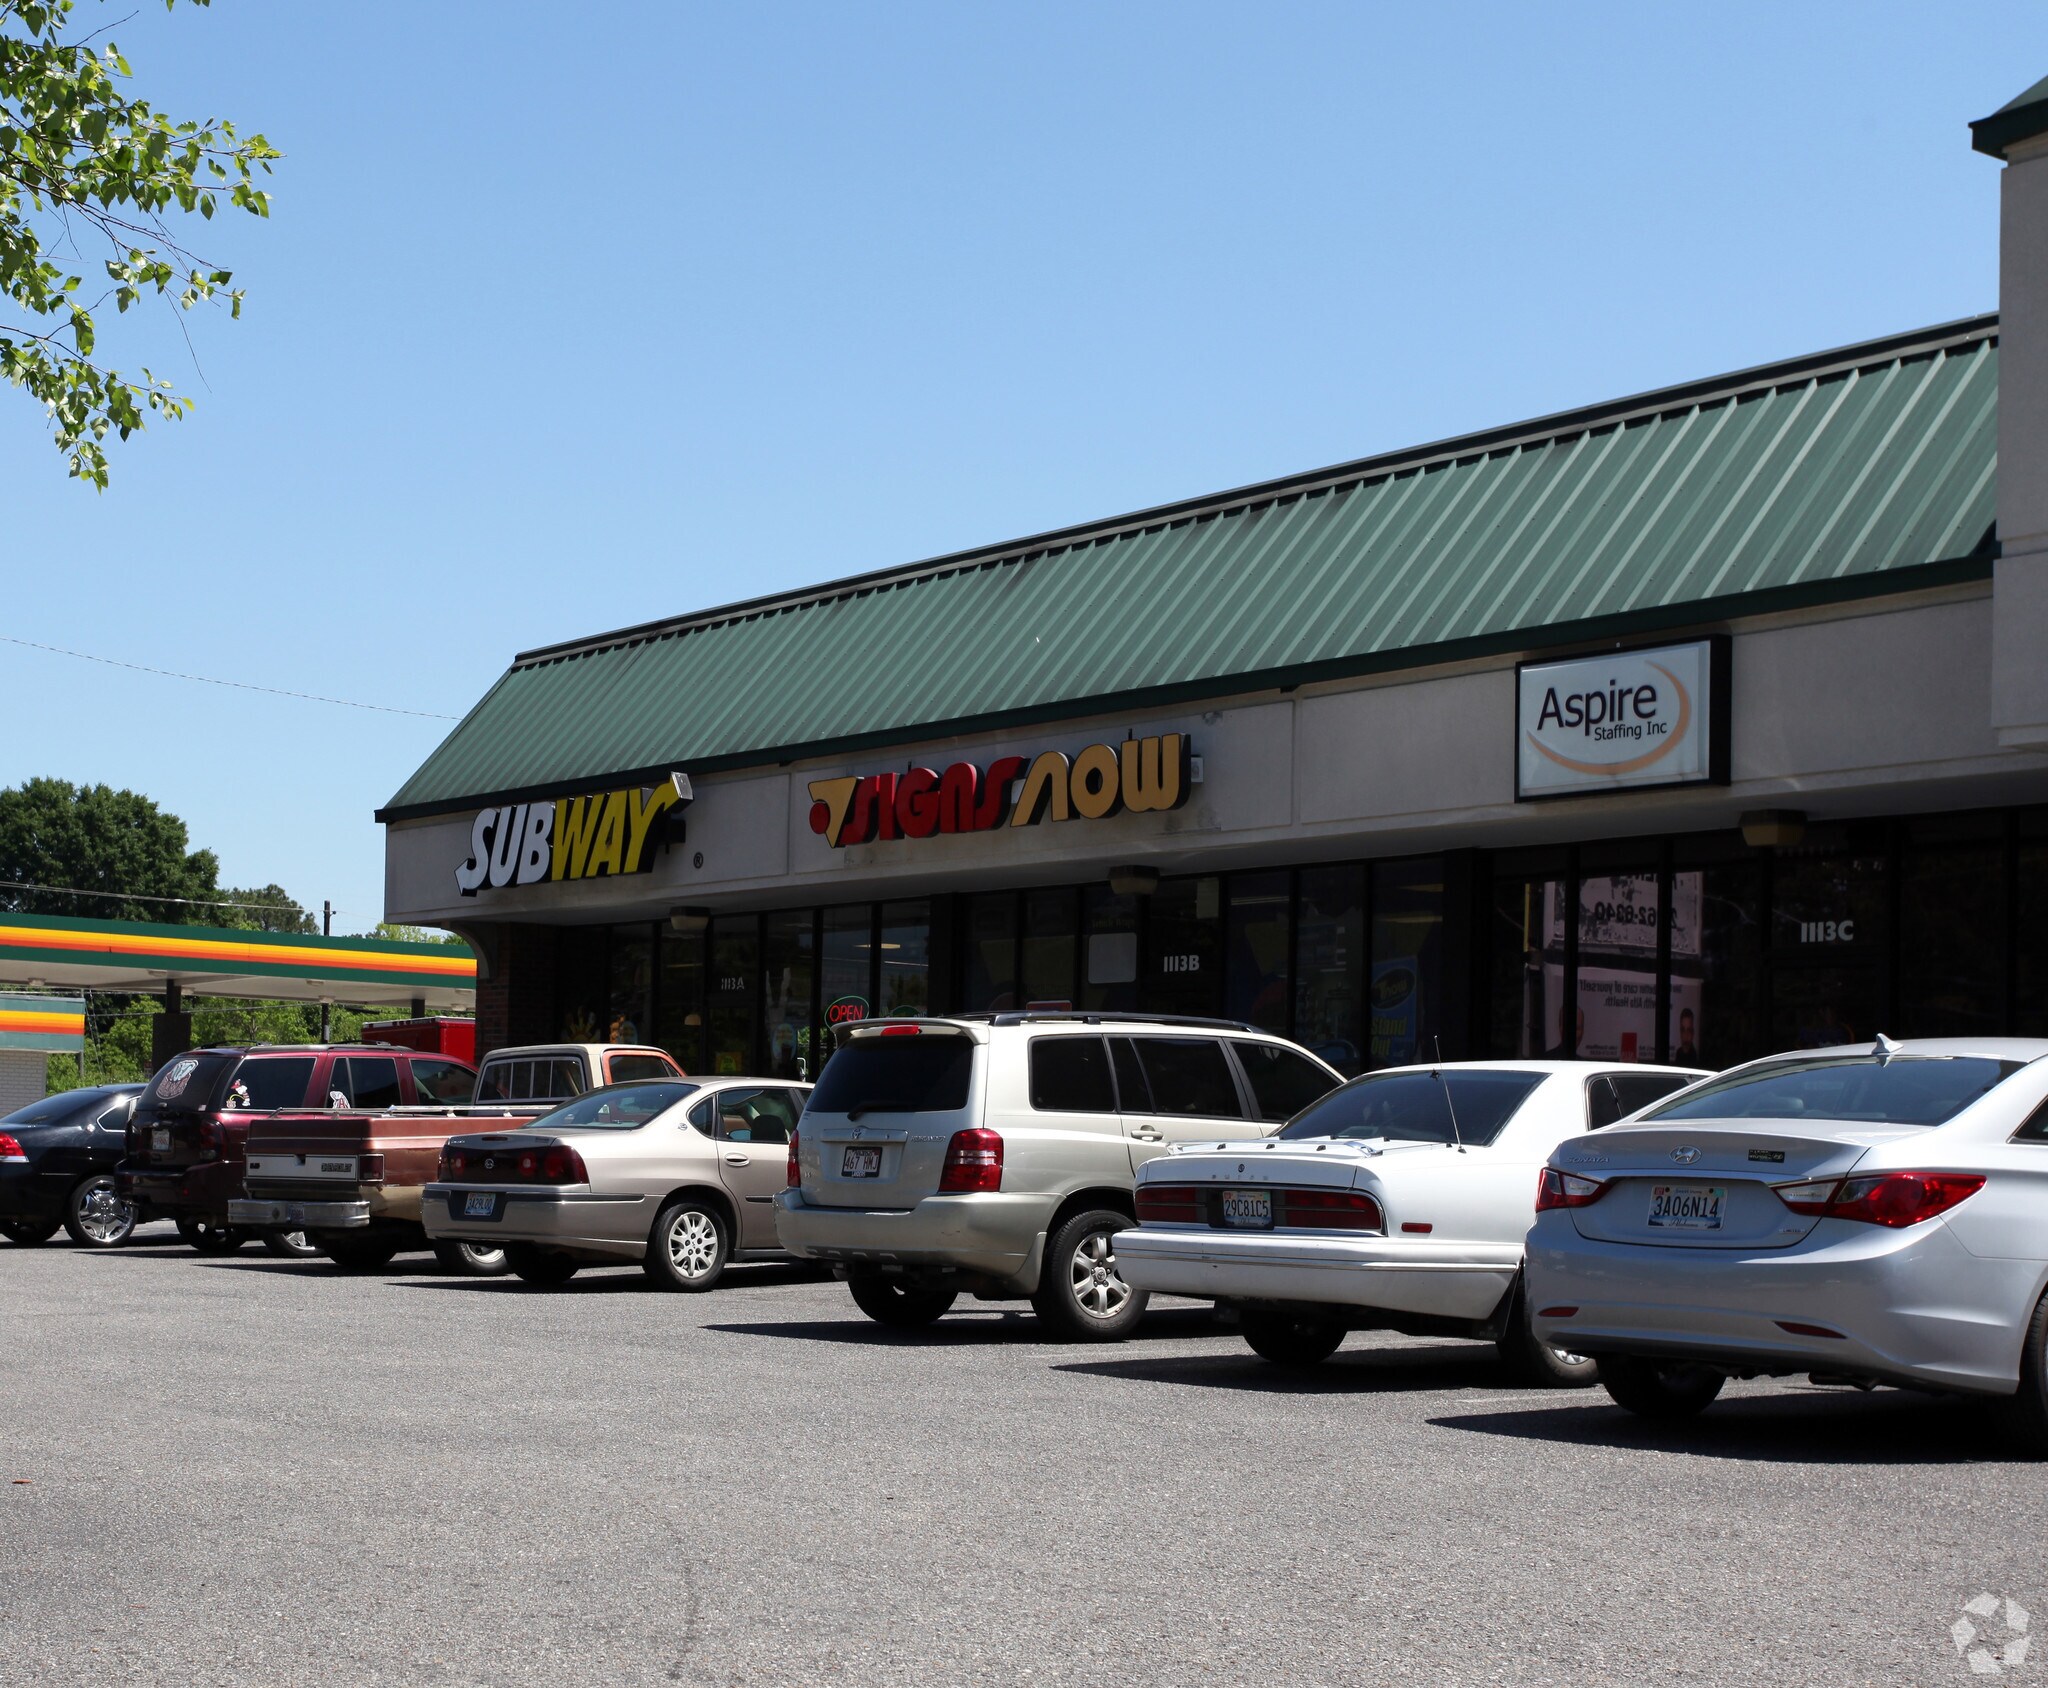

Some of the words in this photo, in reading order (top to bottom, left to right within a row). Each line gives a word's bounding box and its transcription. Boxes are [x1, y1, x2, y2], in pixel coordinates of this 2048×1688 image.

[1537, 679, 1657, 736] Aspire
[1594, 723, 1642, 741] Staffing
[1647, 720, 1667, 736] Inc
[454, 771, 693, 897] SUBWAY
[1800, 920, 1854, 942] 1113C
[1164, 954, 1199, 972] 1113B
[721, 976, 744, 991] 1113A
[829, 1004, 863, 1022] OPEN
[844, 1156, 859, 1170] 467
[863, 1155, 878, 1170] HMJ
[1225, 1199, 1269, 1217] 29C81C5
[1654, 1196, 1719, 1218] 3A06N14
